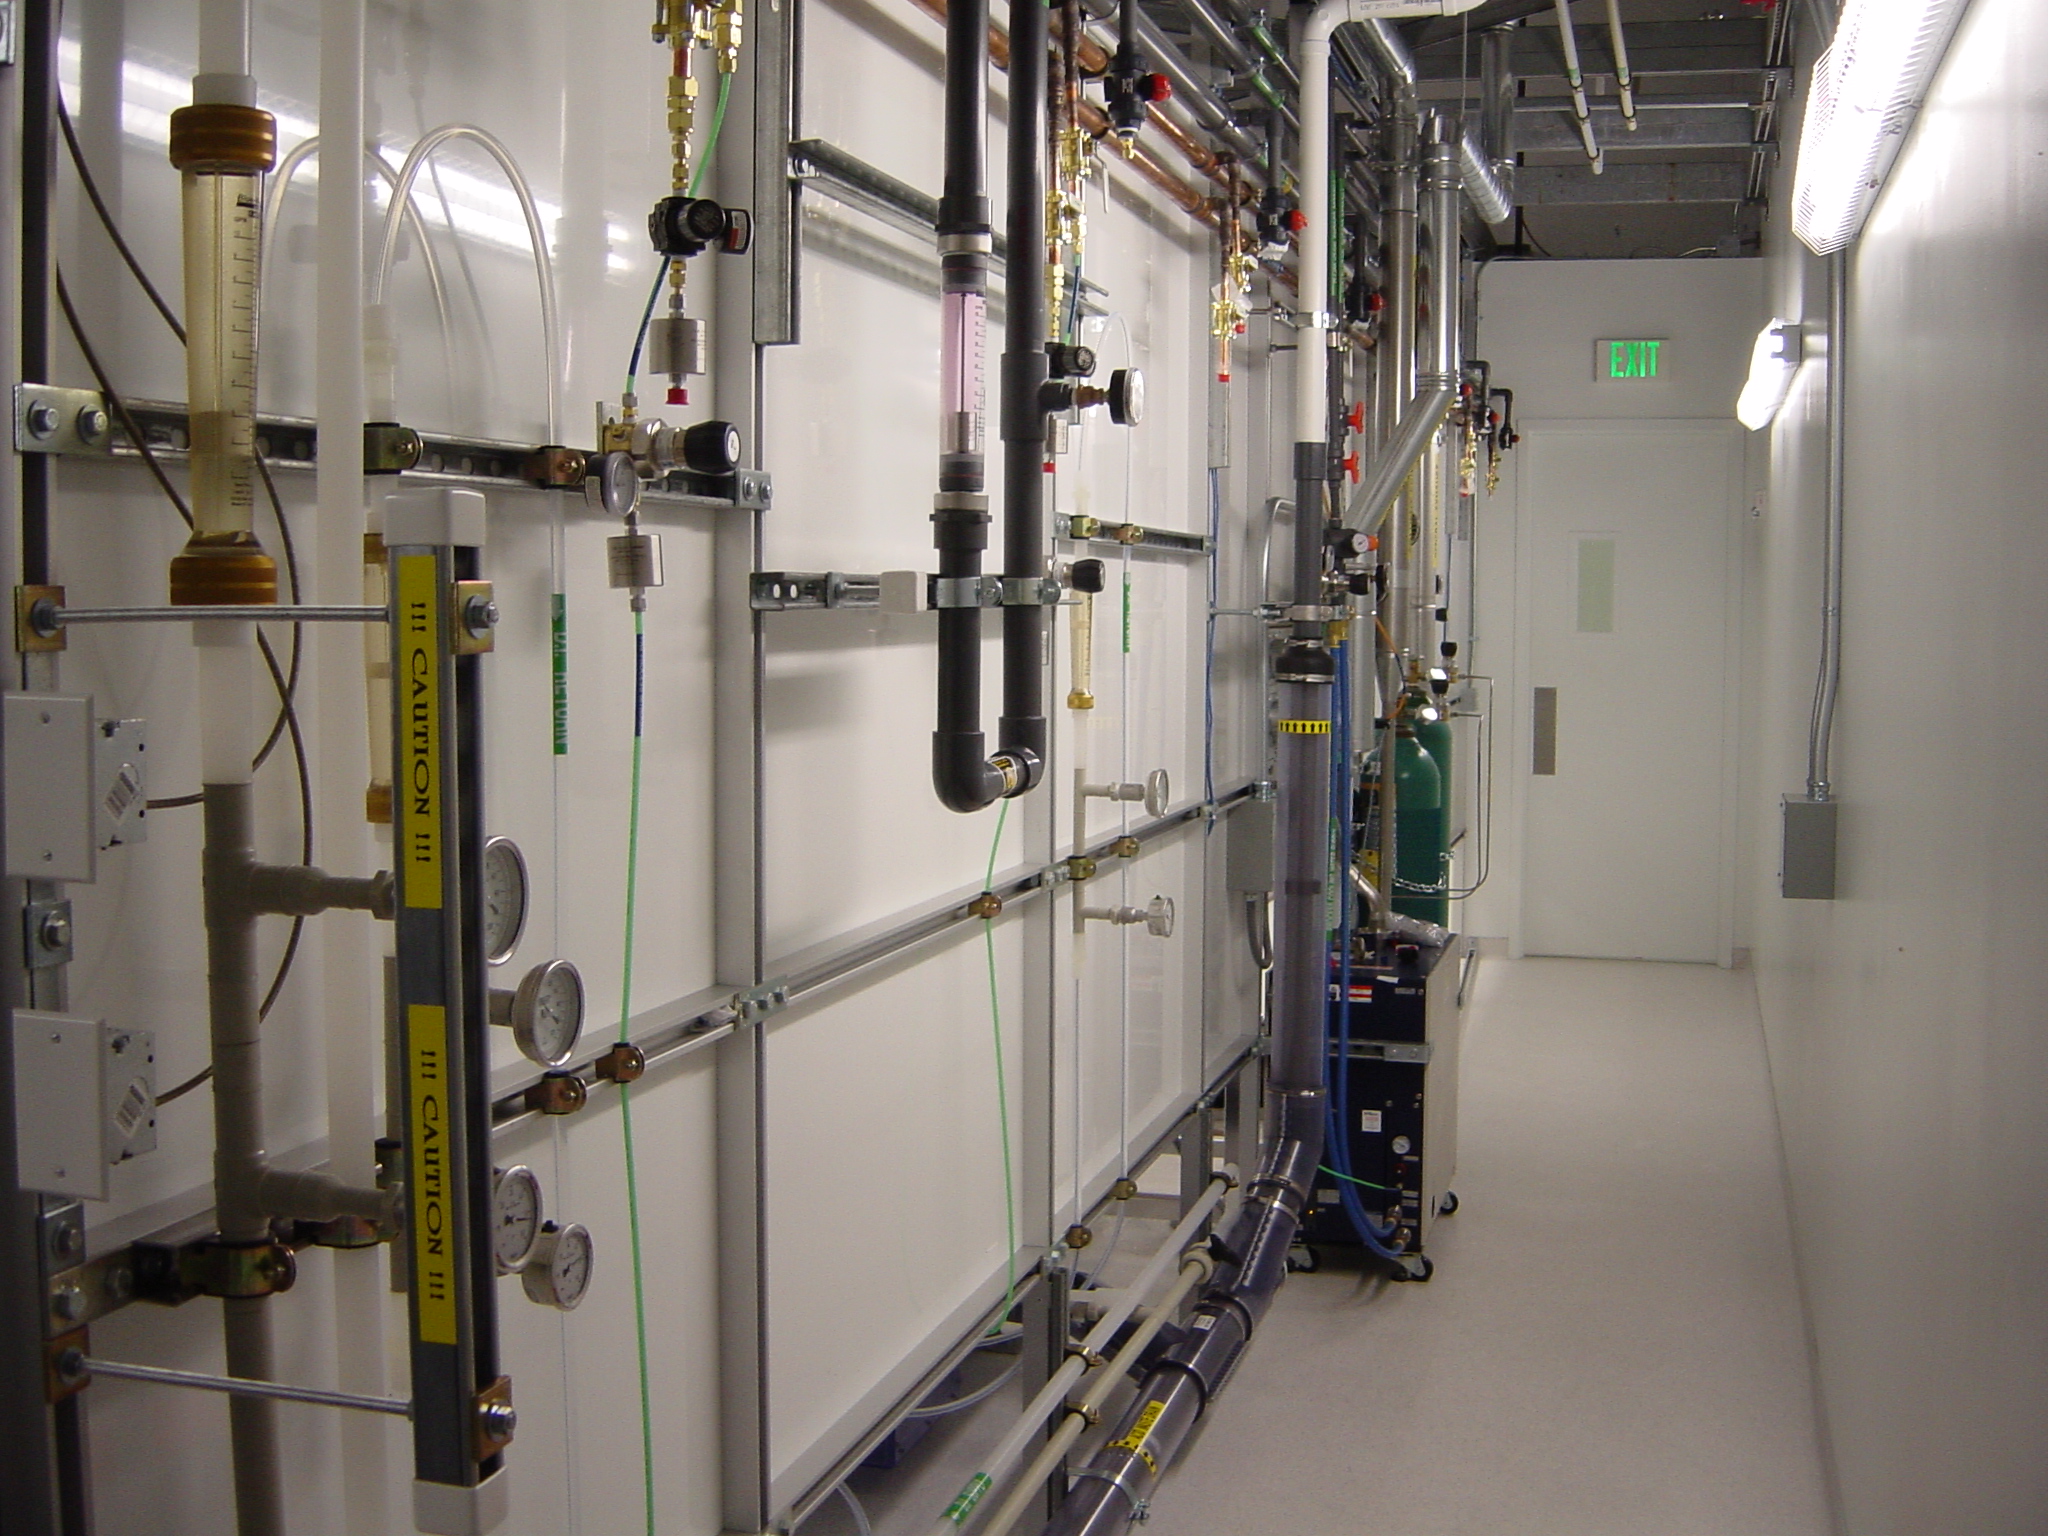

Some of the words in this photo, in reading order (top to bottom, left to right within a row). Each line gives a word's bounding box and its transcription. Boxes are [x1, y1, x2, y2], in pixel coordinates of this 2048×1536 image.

[1610, 341, 1660, 378] EXIT
[411, 648, 431, 818] CAUTION
[422, 1095, 443, 1257] CAUTION
